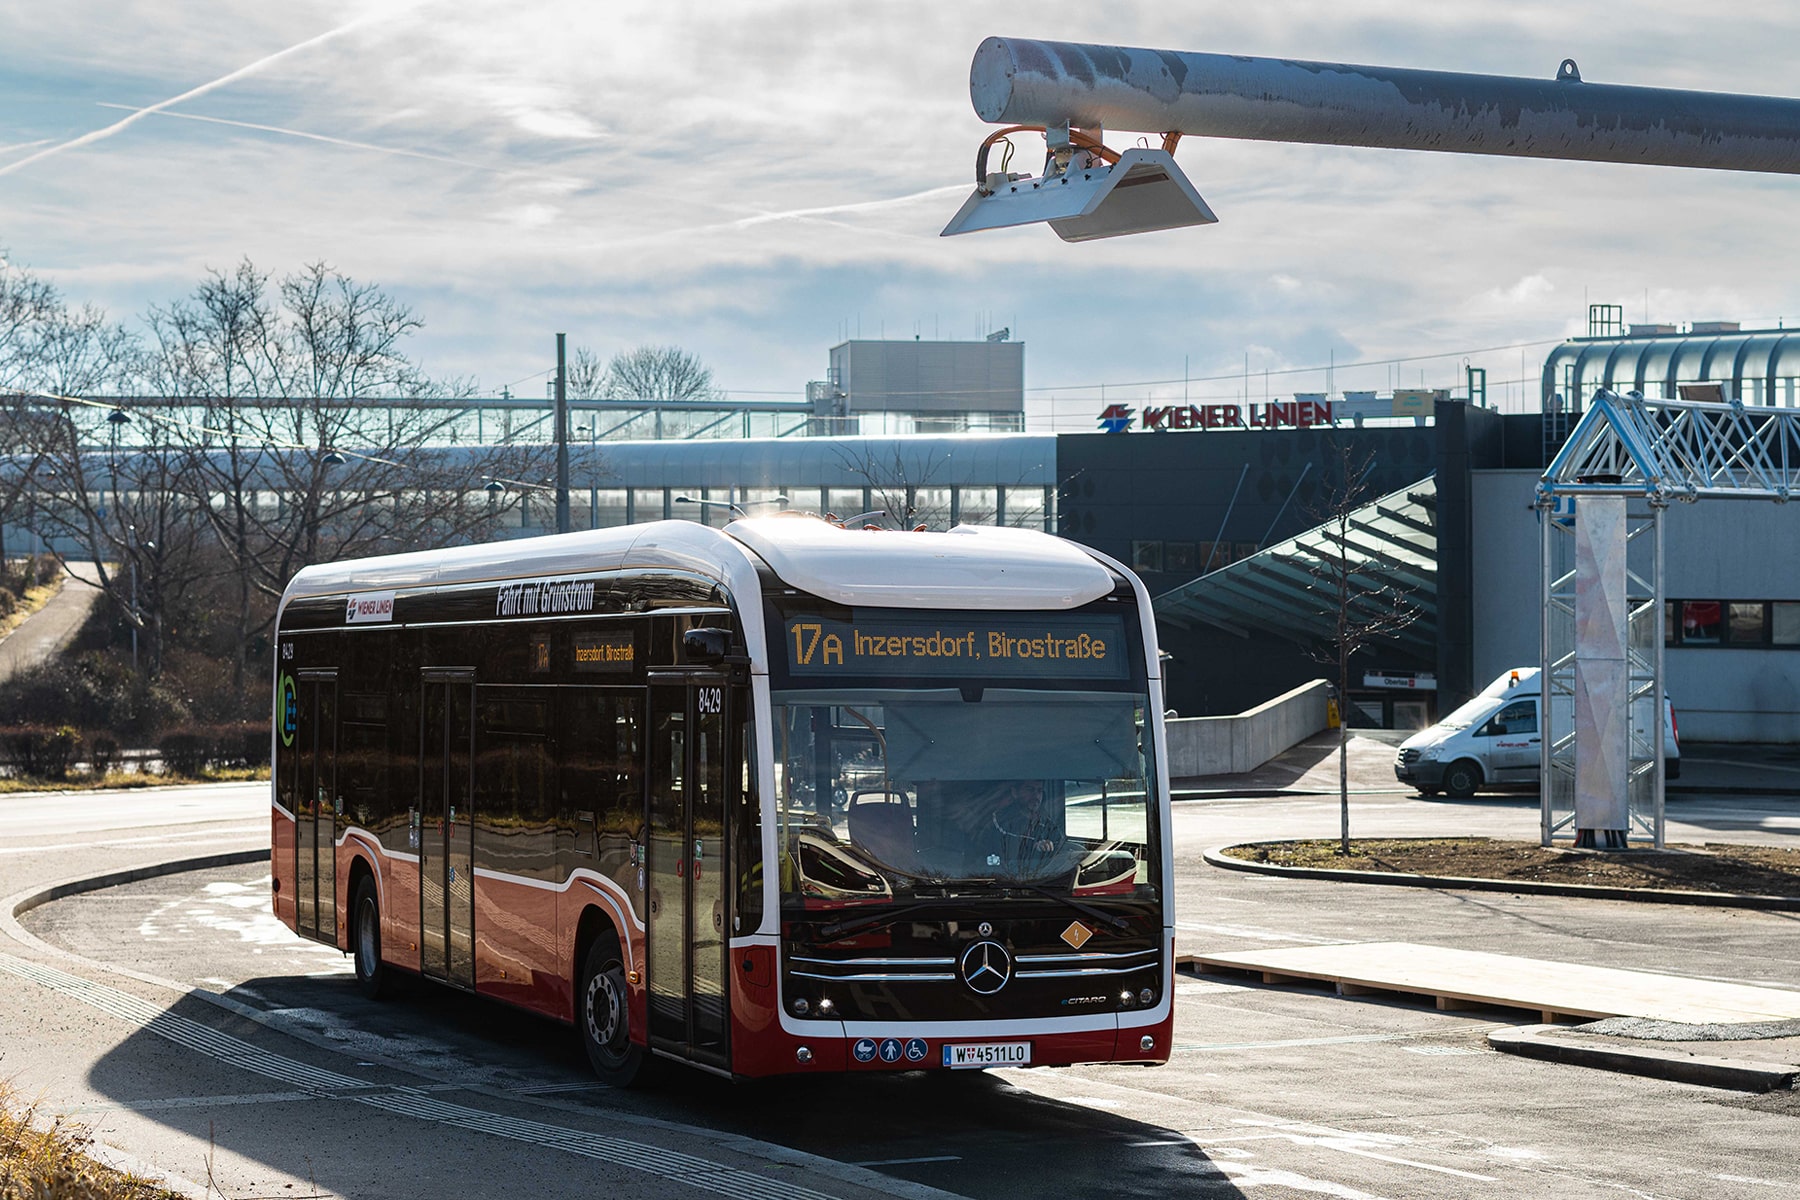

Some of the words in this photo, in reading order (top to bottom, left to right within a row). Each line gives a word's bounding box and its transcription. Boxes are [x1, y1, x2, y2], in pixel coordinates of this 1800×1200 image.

[1143, 404, 1243, 430] WIENER
[1249, 401, 1334, 429] LINIEN
[358, 600, 376, 616] WIENER
[376, 598, 392, 615] LINIEN
[496, 582, 523, 617] Fährt
[523, 580, 541, 615] mit
[541, 577, 595, 614] Grünstrom
[790, 622, 844, 666] 17A
[854, 629, 982, 661] Inzersdorf,
[988, 630, 1107, 659] Birostraße
[698, 687, 722, 714] 8429
